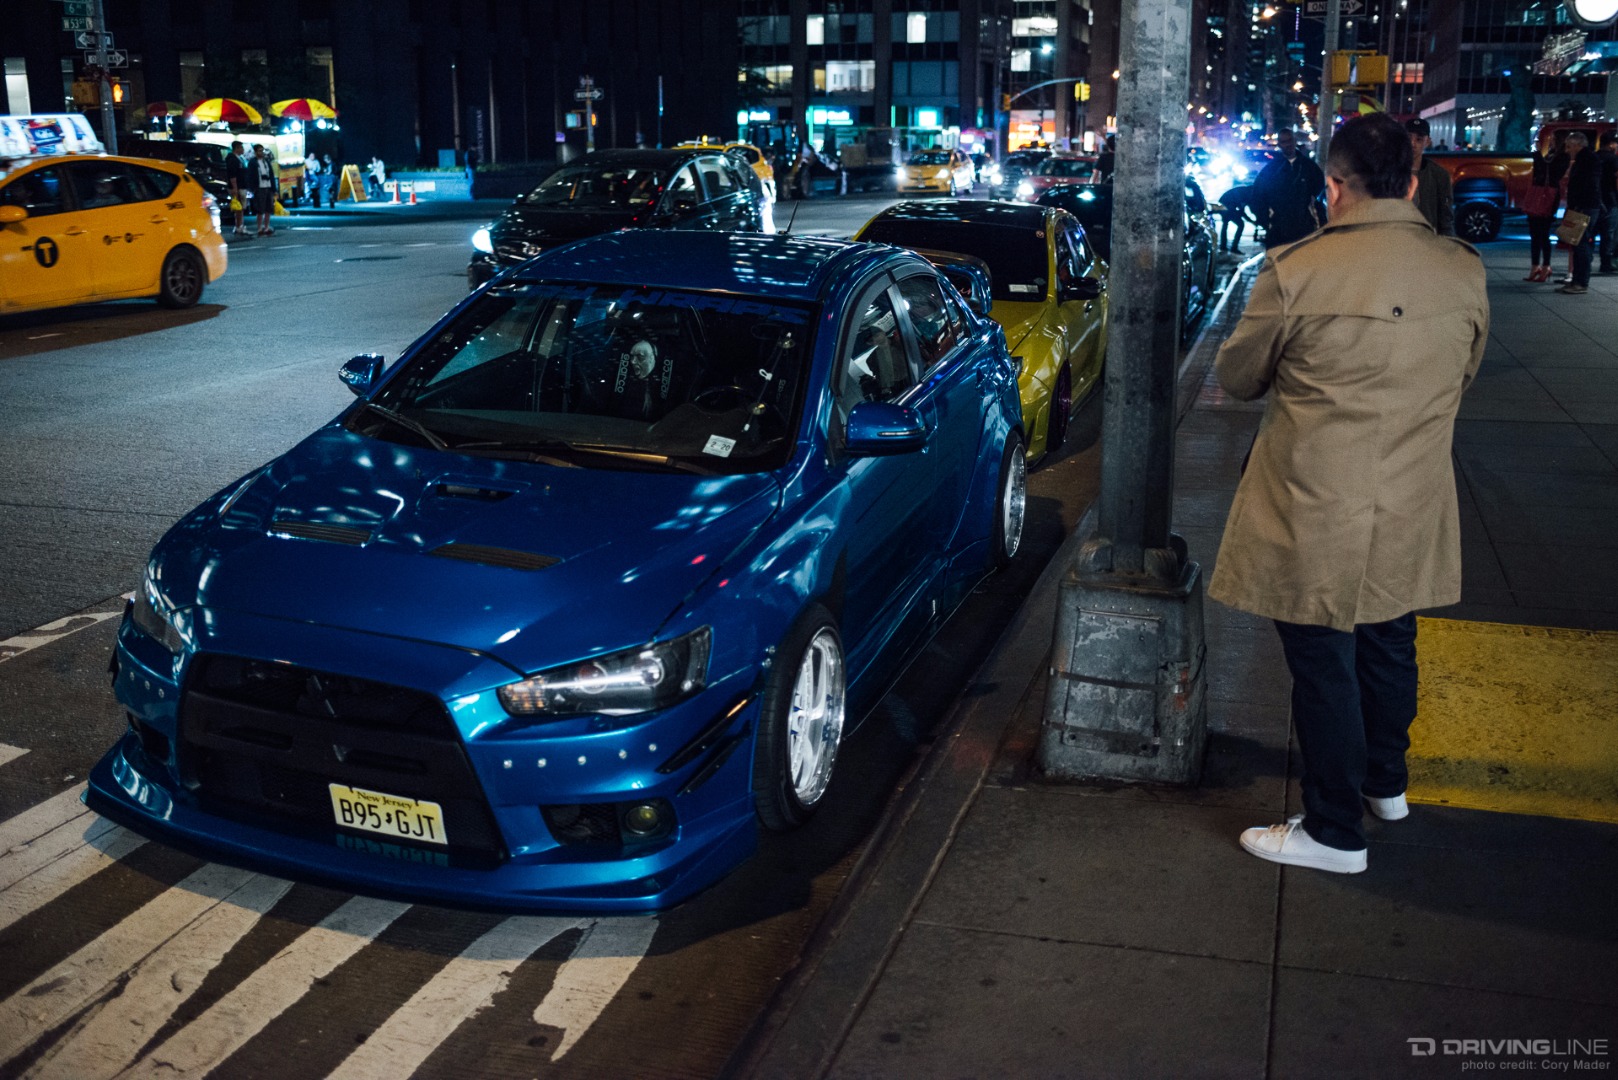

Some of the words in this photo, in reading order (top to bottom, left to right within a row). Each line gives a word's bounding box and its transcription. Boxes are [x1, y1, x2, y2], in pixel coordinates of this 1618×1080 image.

[70, 18, 79, 29] 53
[37, 242, 53, 264] T
[616, 353, 630, 394] sparco
[356, 791, 380, 802] New
[381, 796, 413, 809] Jersey
